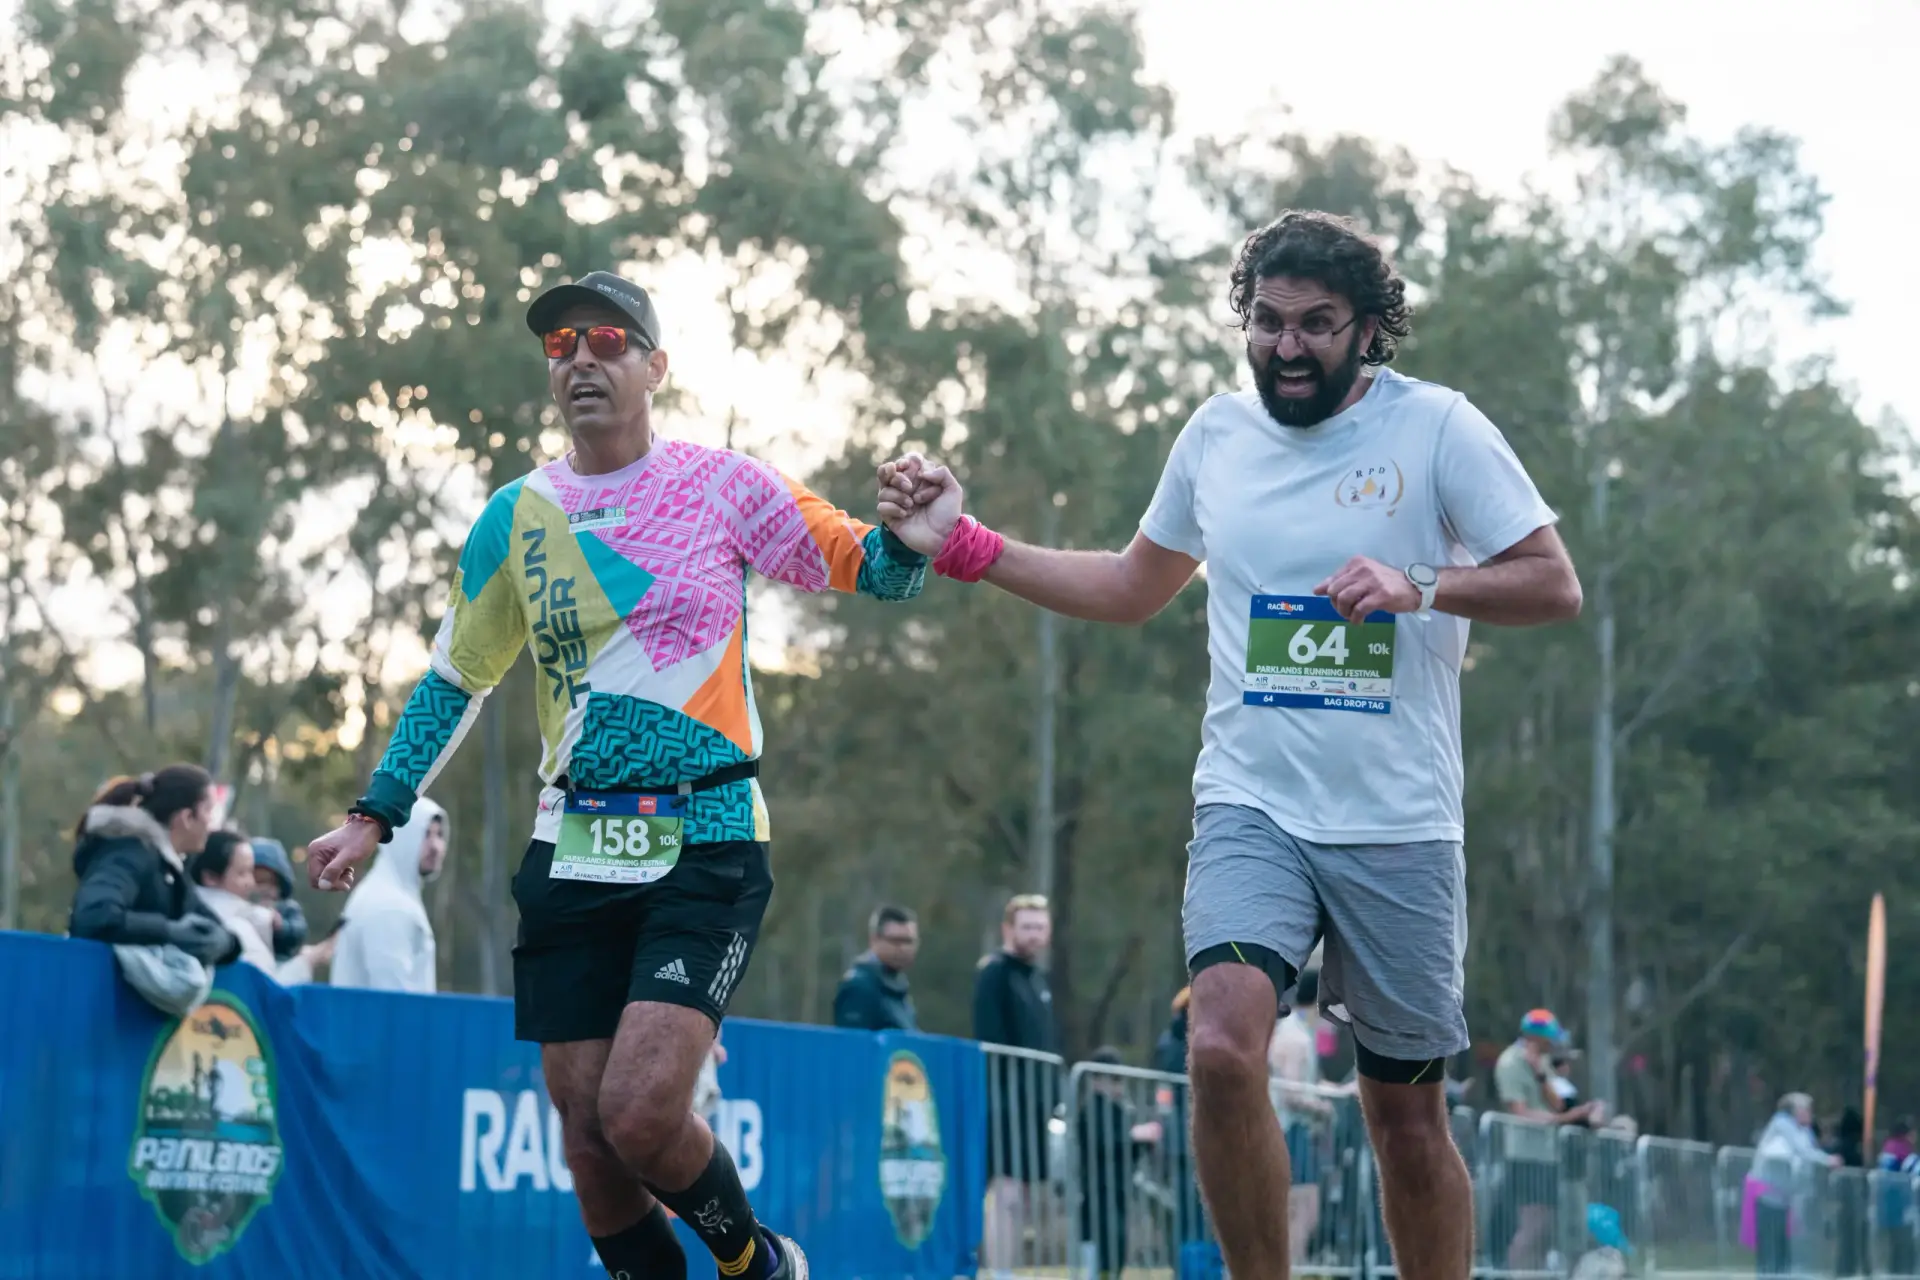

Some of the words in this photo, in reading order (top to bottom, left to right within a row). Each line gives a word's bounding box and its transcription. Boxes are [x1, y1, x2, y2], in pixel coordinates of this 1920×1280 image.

[550, 576, 592, 709] TEER
[1288, 624, 1349, 665] 64
[1368, 643, 1391, 655] 10k
[1256, 665, 1302, 675] PARKLANDS
[1304, 667, 1343, 677] RUNNING
[1345, 669, 1380, 678] FESTIVAL
[1255, 676, 1268, 684] AIR
[1324, 698, 1342, 706] BAG
[1343, 699, 1366, 709] DROP
[1368, 700, 1385, 710] TAG
[590, 818, 650, 857] 158
[659, 835, 679, 846] 10k
[562, 854, 606, 866] PARKLANDS
[606, 858, 640, 867] RUNNING
[640, 859, 668, 868] FESTIVAL
[654, 971, 690, 985] adidas
